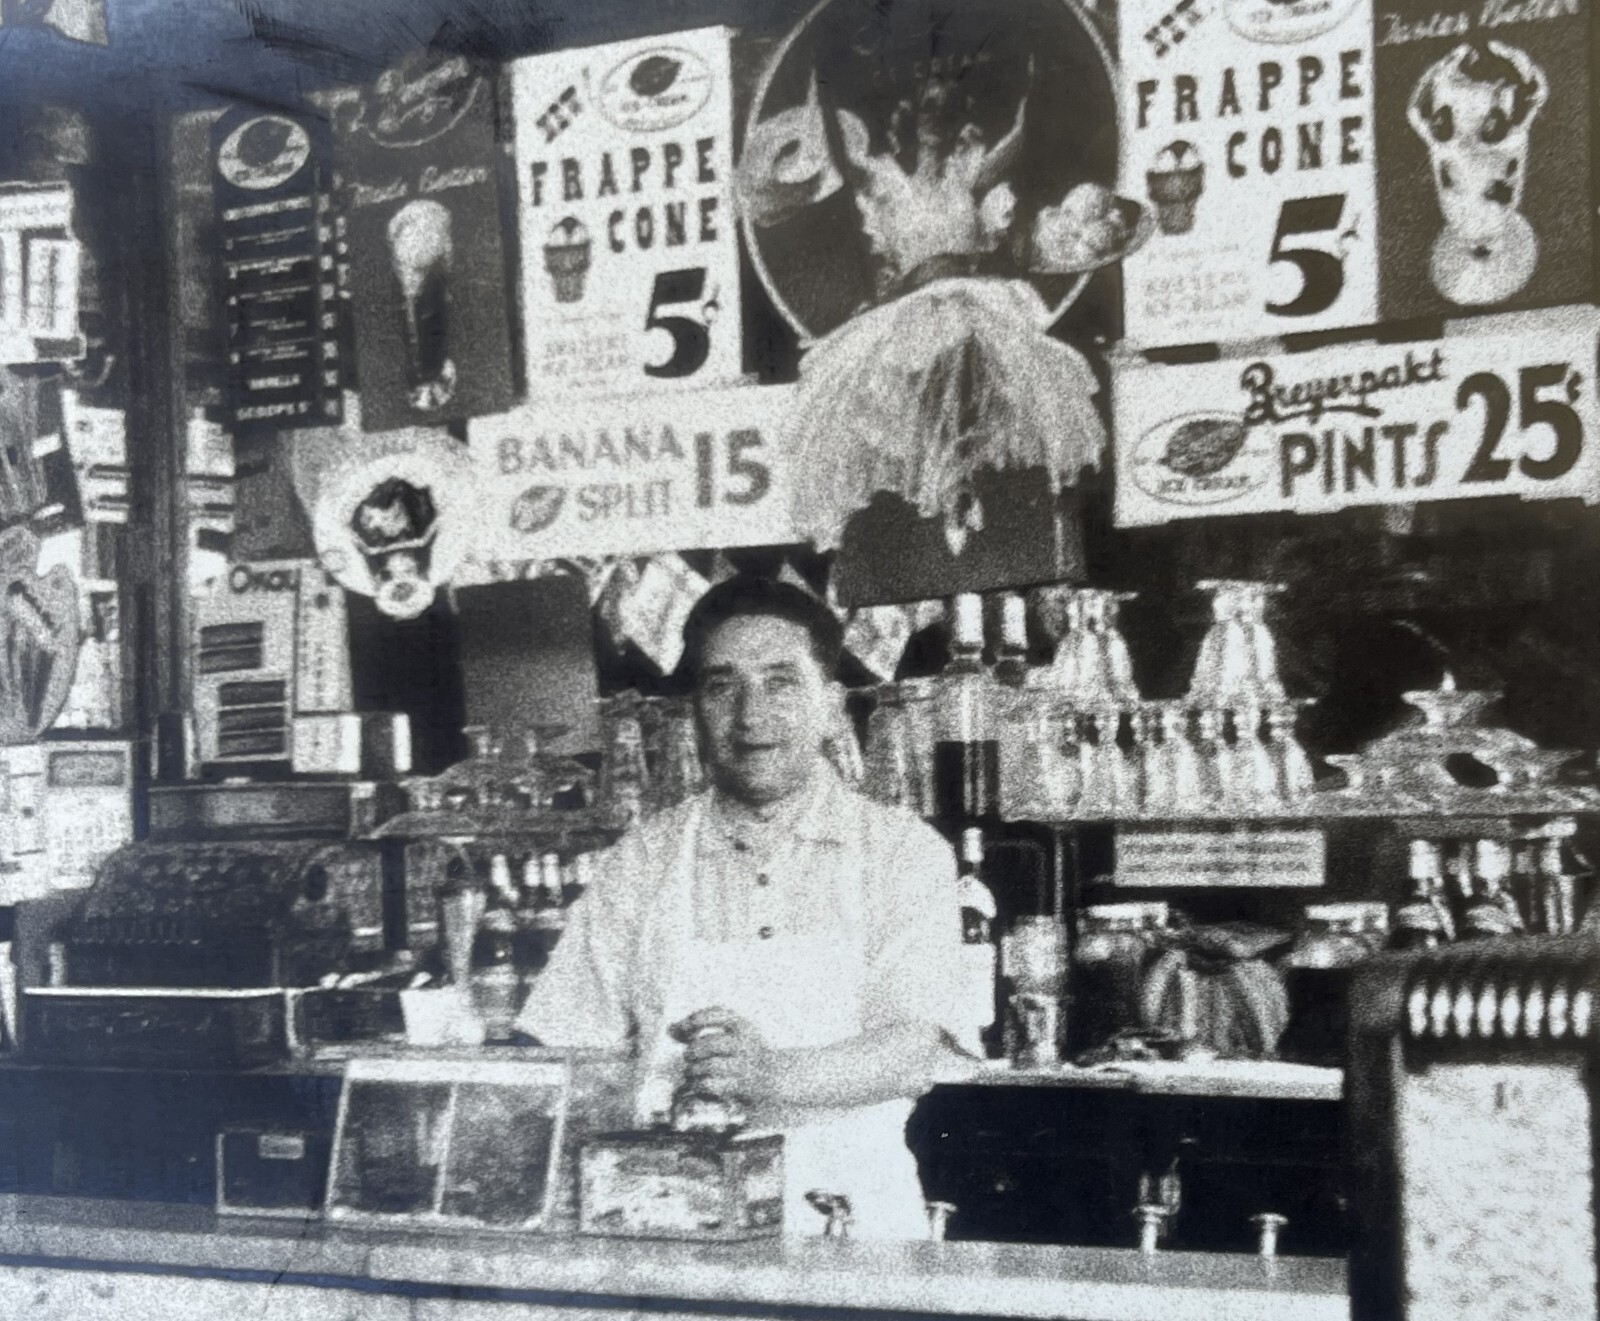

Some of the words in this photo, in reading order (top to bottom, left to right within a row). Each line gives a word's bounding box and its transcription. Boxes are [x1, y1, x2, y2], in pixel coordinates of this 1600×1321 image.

[1136, 48, 1364, 130] FRAPPE
[530, 135, 717, 208] FRAPPE
[1224, 115, 1363, 180] CONE
[607, 196, 719, 254] CONE
[498, 423, 687, 476] BANANA
[693, 428, 771, 510] 15
[1280, 420, 1449, 499] PINTS
[574, 477, 672, 523] SPLIT
